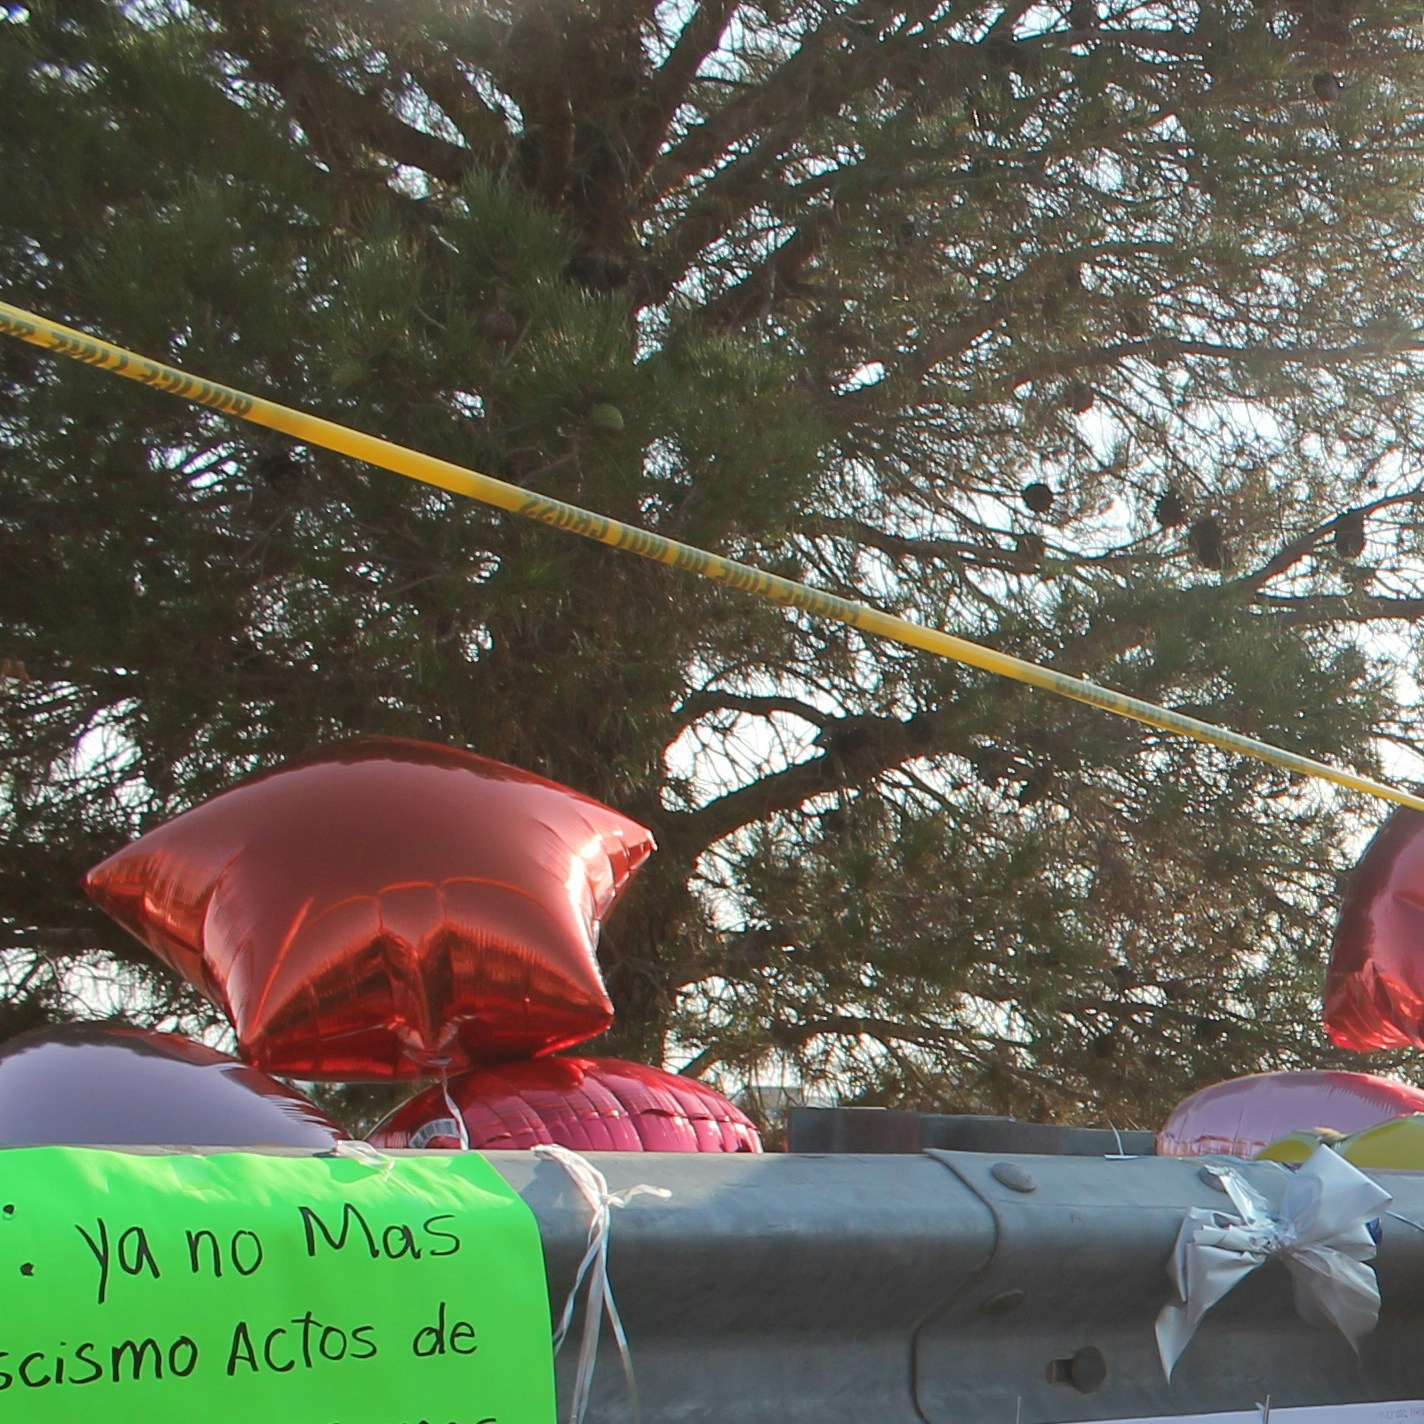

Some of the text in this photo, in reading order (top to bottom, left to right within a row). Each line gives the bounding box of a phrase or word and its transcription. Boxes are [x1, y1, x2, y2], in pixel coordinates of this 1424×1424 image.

[186, 1227, 264, 1278] no
[299, 1203, 461, 1259] Mas
[412, 1301, 478, 1358] de
